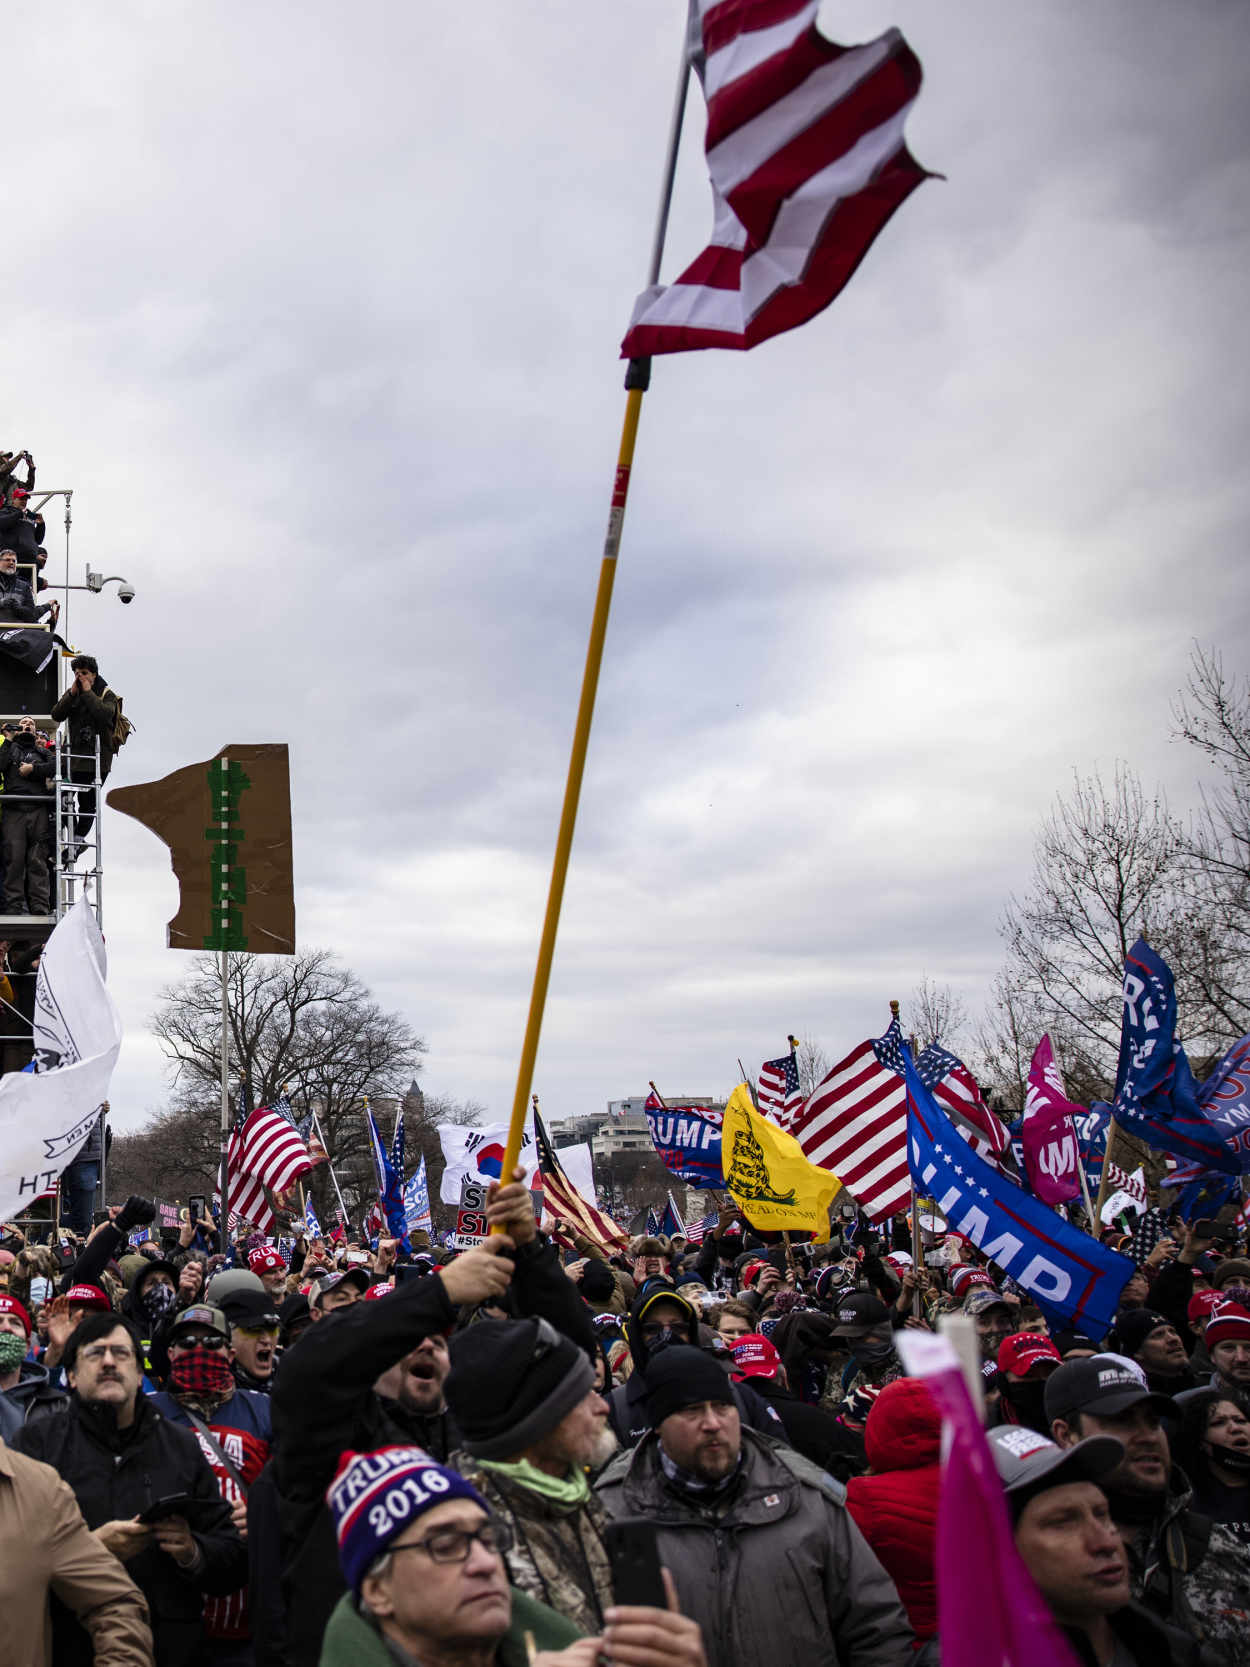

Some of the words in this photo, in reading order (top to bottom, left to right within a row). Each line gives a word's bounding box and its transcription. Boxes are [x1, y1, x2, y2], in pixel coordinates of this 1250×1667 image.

[159, 1203, 178, 1219] SAVE
[1012, 1338, 1051, 1352] TRUMP
[630, 1427, 647, 1437] Frank
[368, 1468, 451, 1537] 2016
